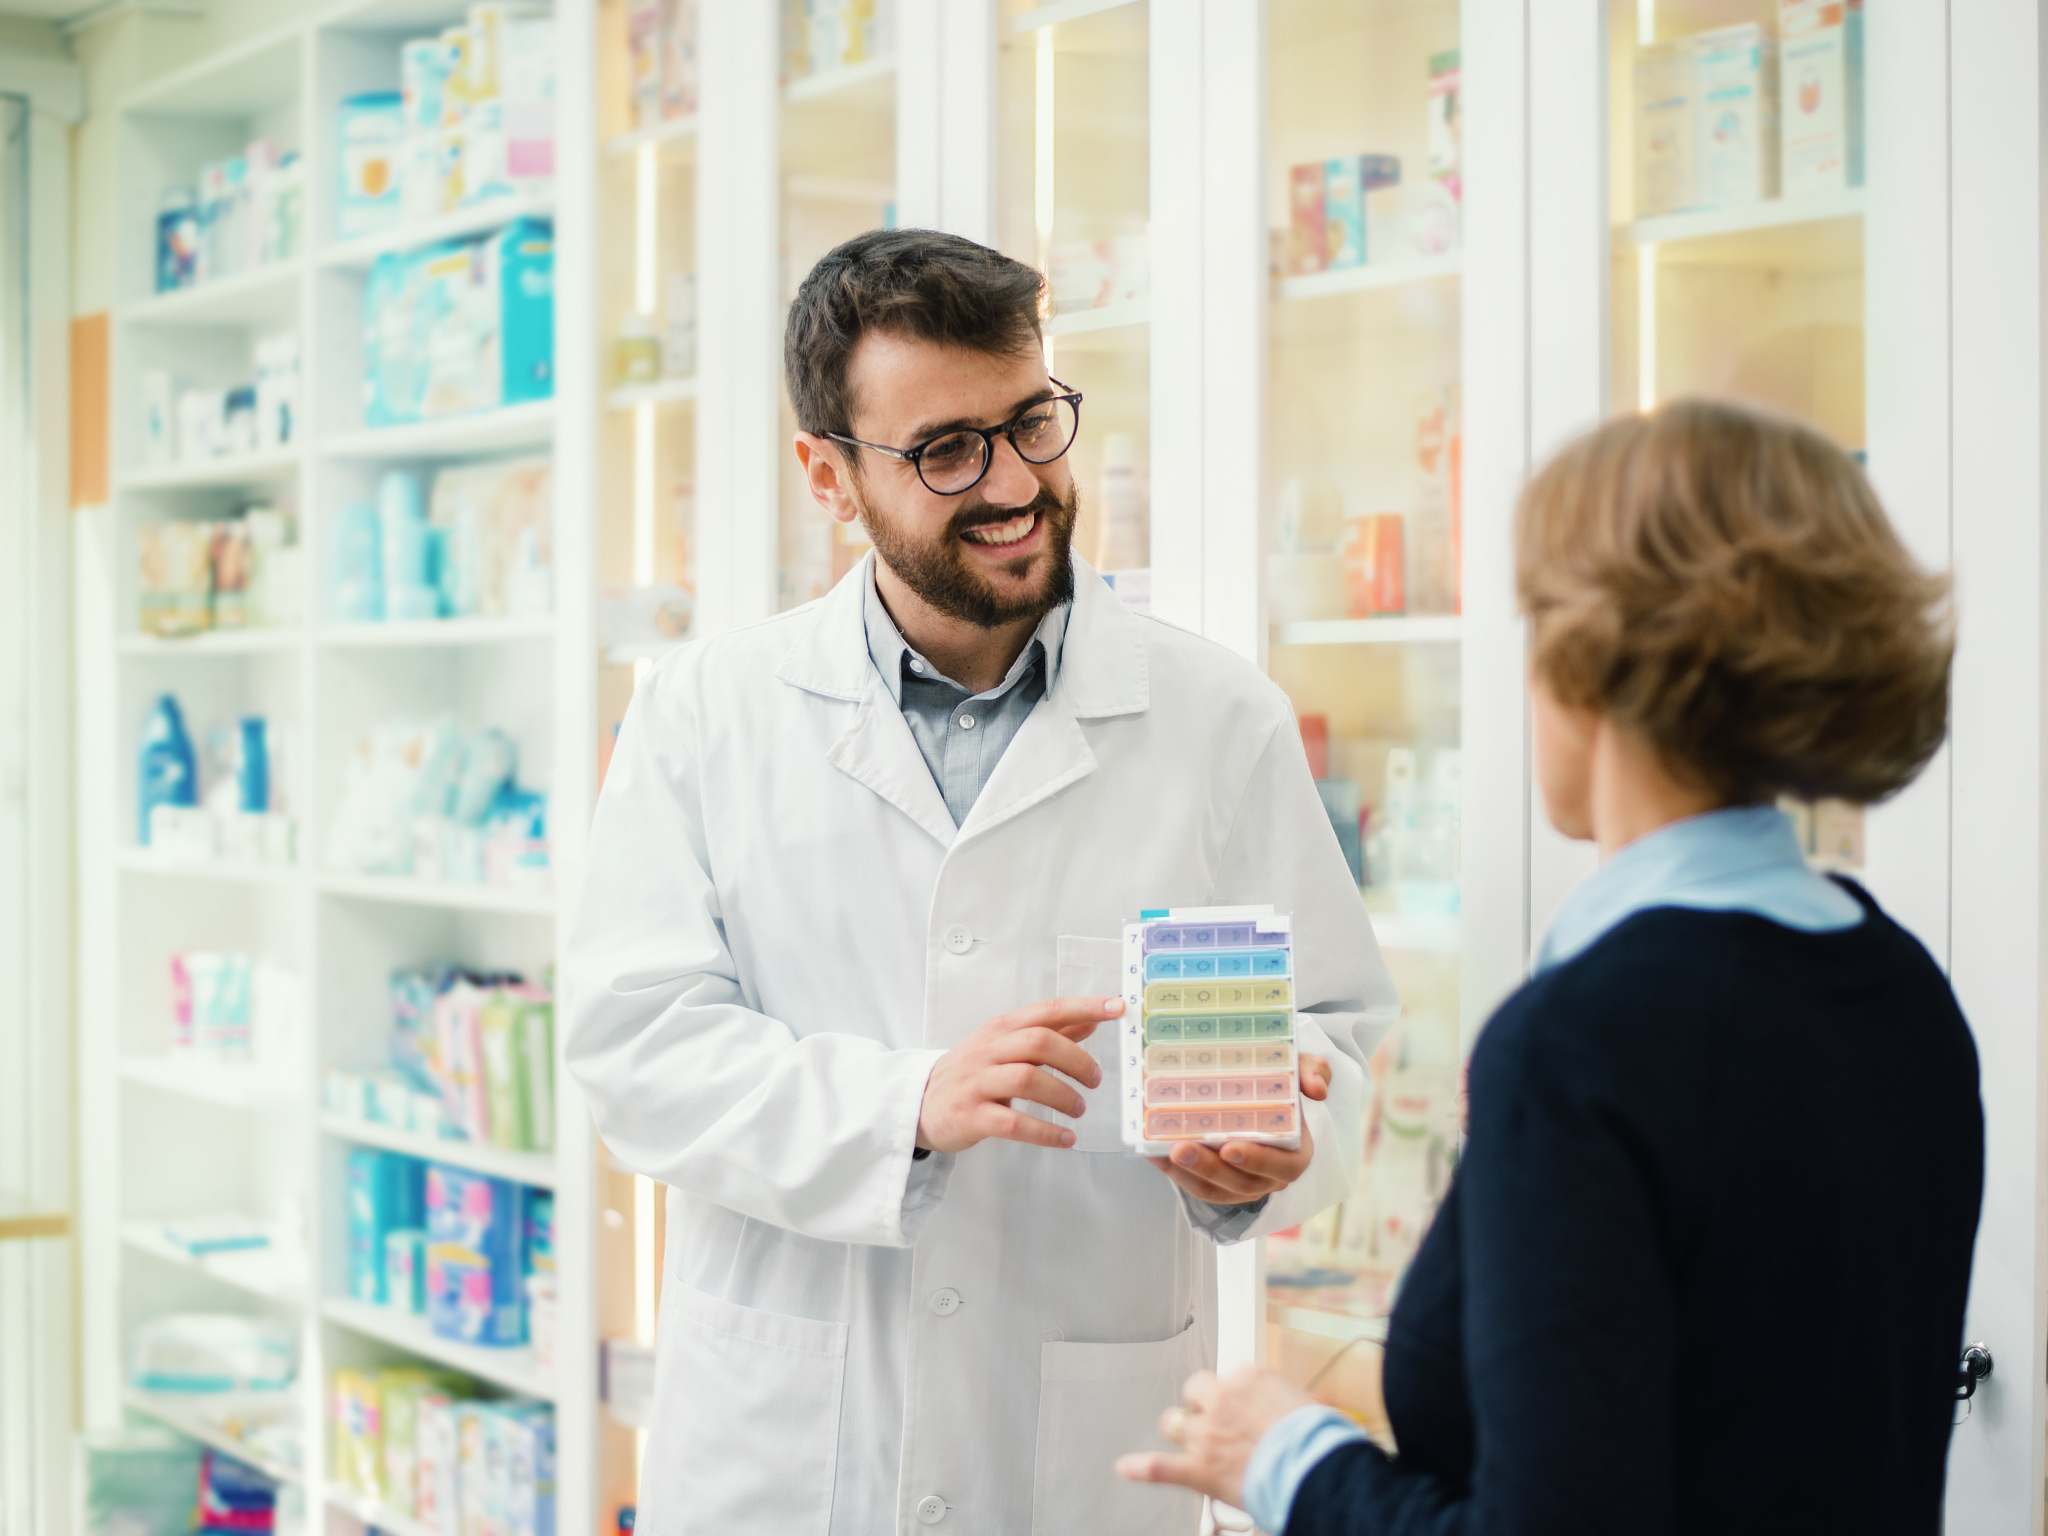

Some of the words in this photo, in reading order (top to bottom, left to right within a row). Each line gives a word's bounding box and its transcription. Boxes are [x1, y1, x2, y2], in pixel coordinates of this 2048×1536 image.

[1130, 934, 1138, 944] 7
[1130, 964, 1138, 974] 6
[1130, 995, 1138, 1005] 5
[1130, 1025, 1137, 1035] 4
[1130, 1056, 1137, 1066] 3
[1130, 1087, 1138, 1097] 2
[1130, 1120, 1137, 1130] 1
